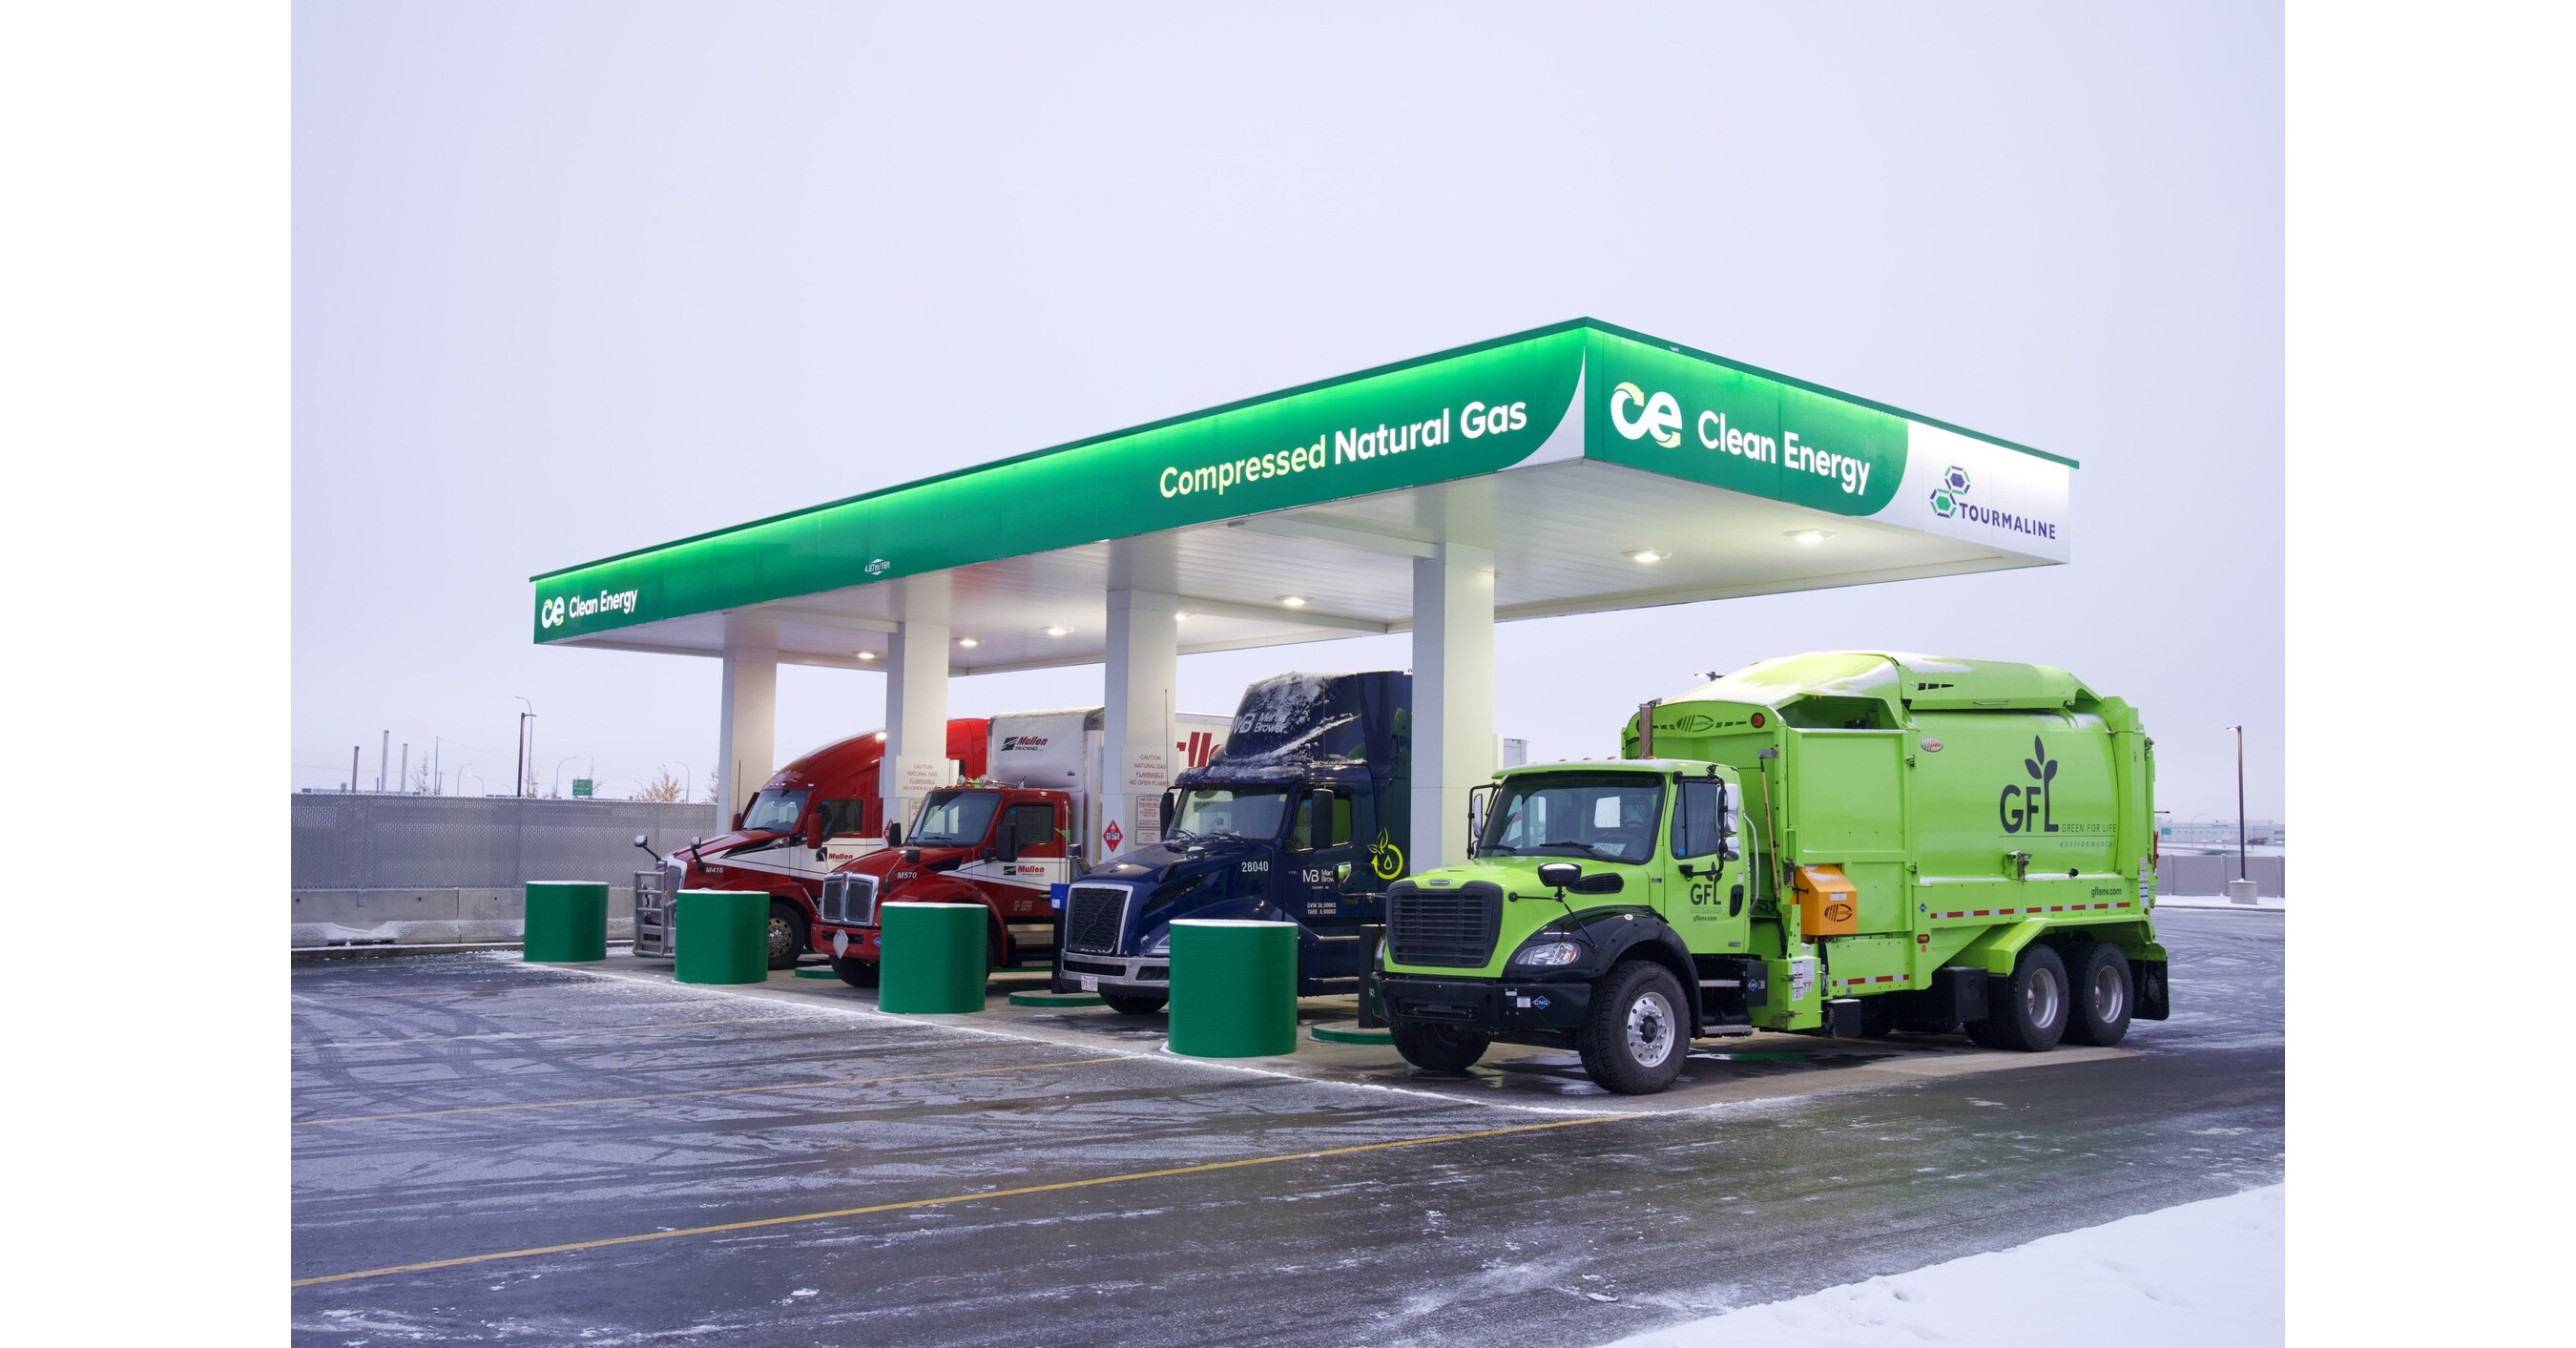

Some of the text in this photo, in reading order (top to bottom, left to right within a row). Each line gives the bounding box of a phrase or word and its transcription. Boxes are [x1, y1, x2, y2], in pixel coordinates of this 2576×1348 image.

[1160, 401, 1527, 498] Compressed Natural Gas
[1698, 410, 1776, 464] Clean
[1784, 430, 1871, 496] Energy
[1959, 502, 2056, 540] TOURMALINE
[569, 594, 598, 618] Clean
[600, 590, 638, 613] Energy
[1016, 736, 1048, 746] Mullen
[2000, 761, 2059, 834] GFL
[2061, 823, 2116, 833] GREEN FOR LIFE
[1241, 861, 1269, 872] 28040
[1690, 873, 1721, 905] GFL
[2090, 886, 2123, 898] gflenv.com
